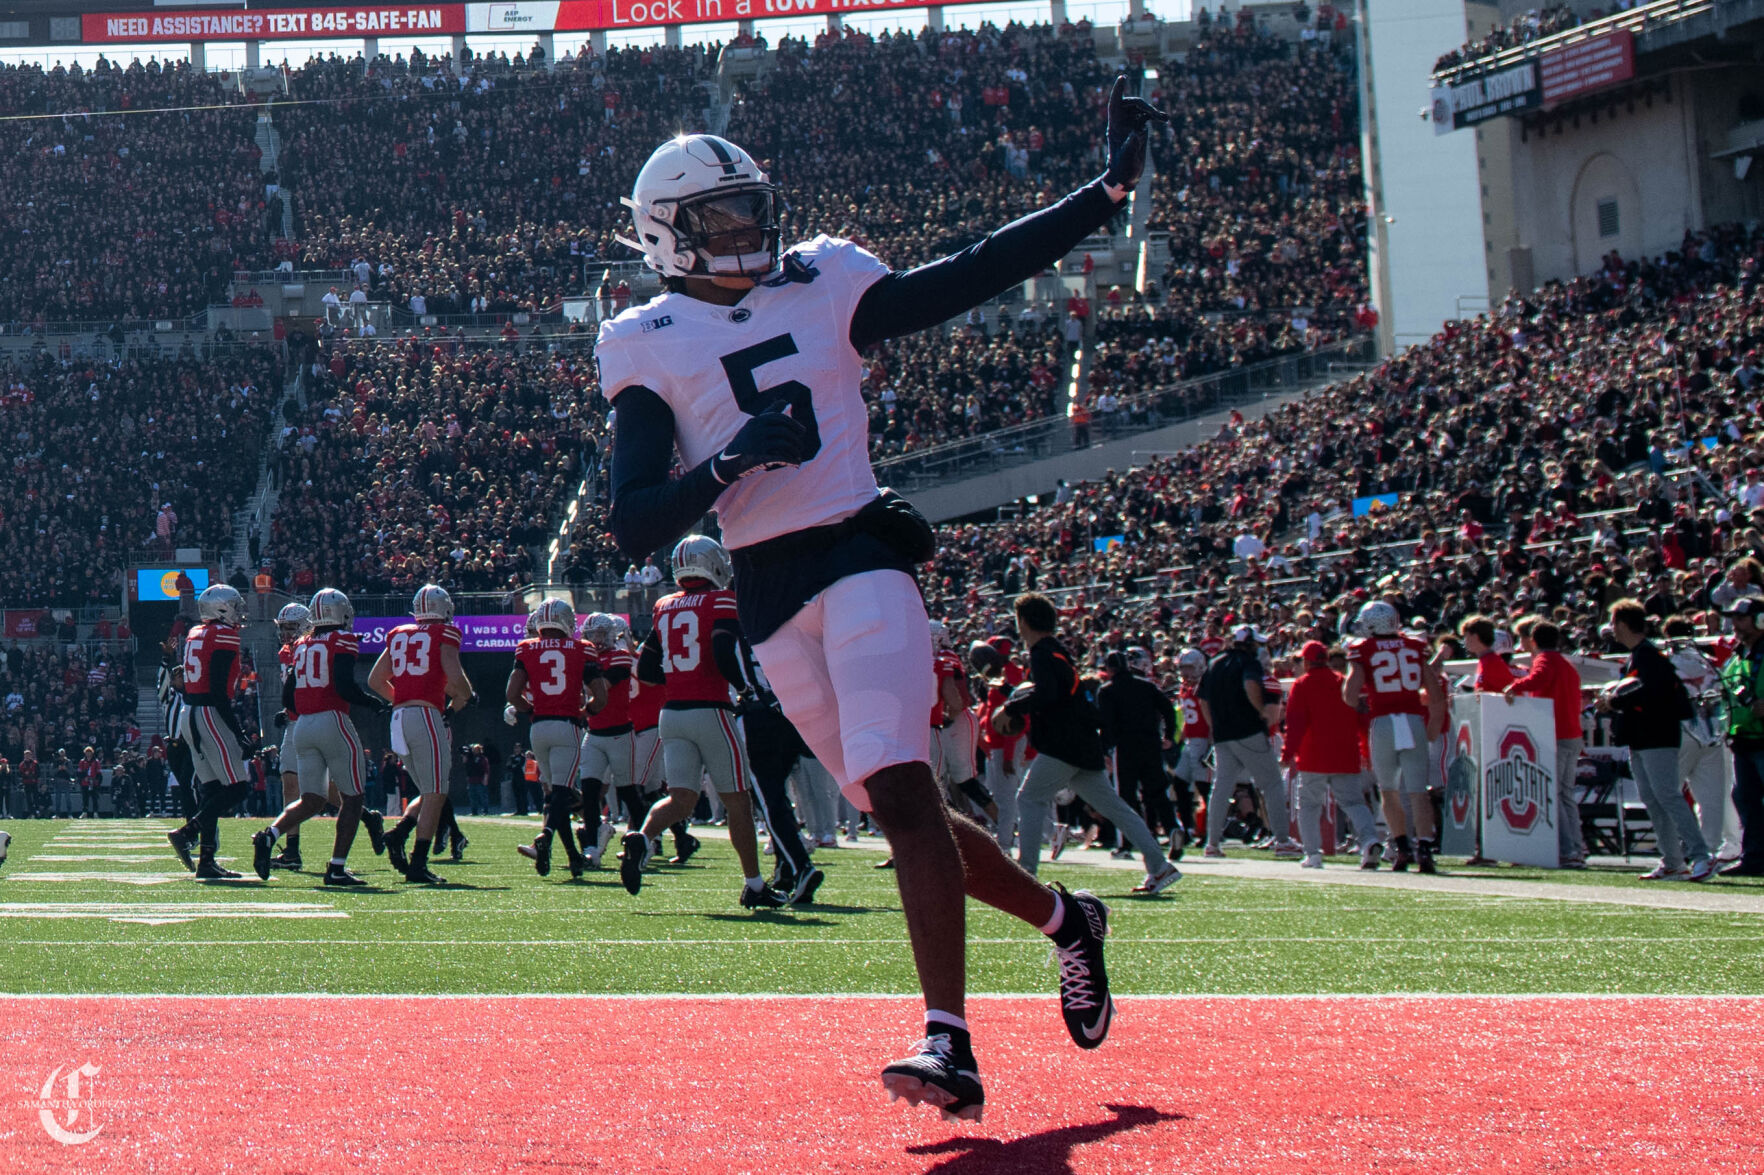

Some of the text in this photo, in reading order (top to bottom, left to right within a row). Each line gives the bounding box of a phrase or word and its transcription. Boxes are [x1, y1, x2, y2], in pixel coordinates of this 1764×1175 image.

[107, 9, 442, 36] NEED ASSISTANCE? TEXT 845-SAFE-FAN
[612, 0, 683, 23] Lock
[696, 0, 722, 17] in
[735, 0, 751, 15] a
[719, 332, 822, 464] 5
[464, 624, 469, 634] I
[473, 626, 497, 634] was
[501, 626, 509, 634] a
[476, 639, 521, 647] CARDAL
[529, 639, 560, 650] STYLES
[658, 610, 701, 673] 13
[294, 643, 330, 689] 20
[390, 632, 432, 677] 83
[539, 650, 567, 696] 3
[1370, 648, 1422, 693] 26
[1486, 760, 1513, 820] OHIO
[1514, 754, 1554, 829] STATE
